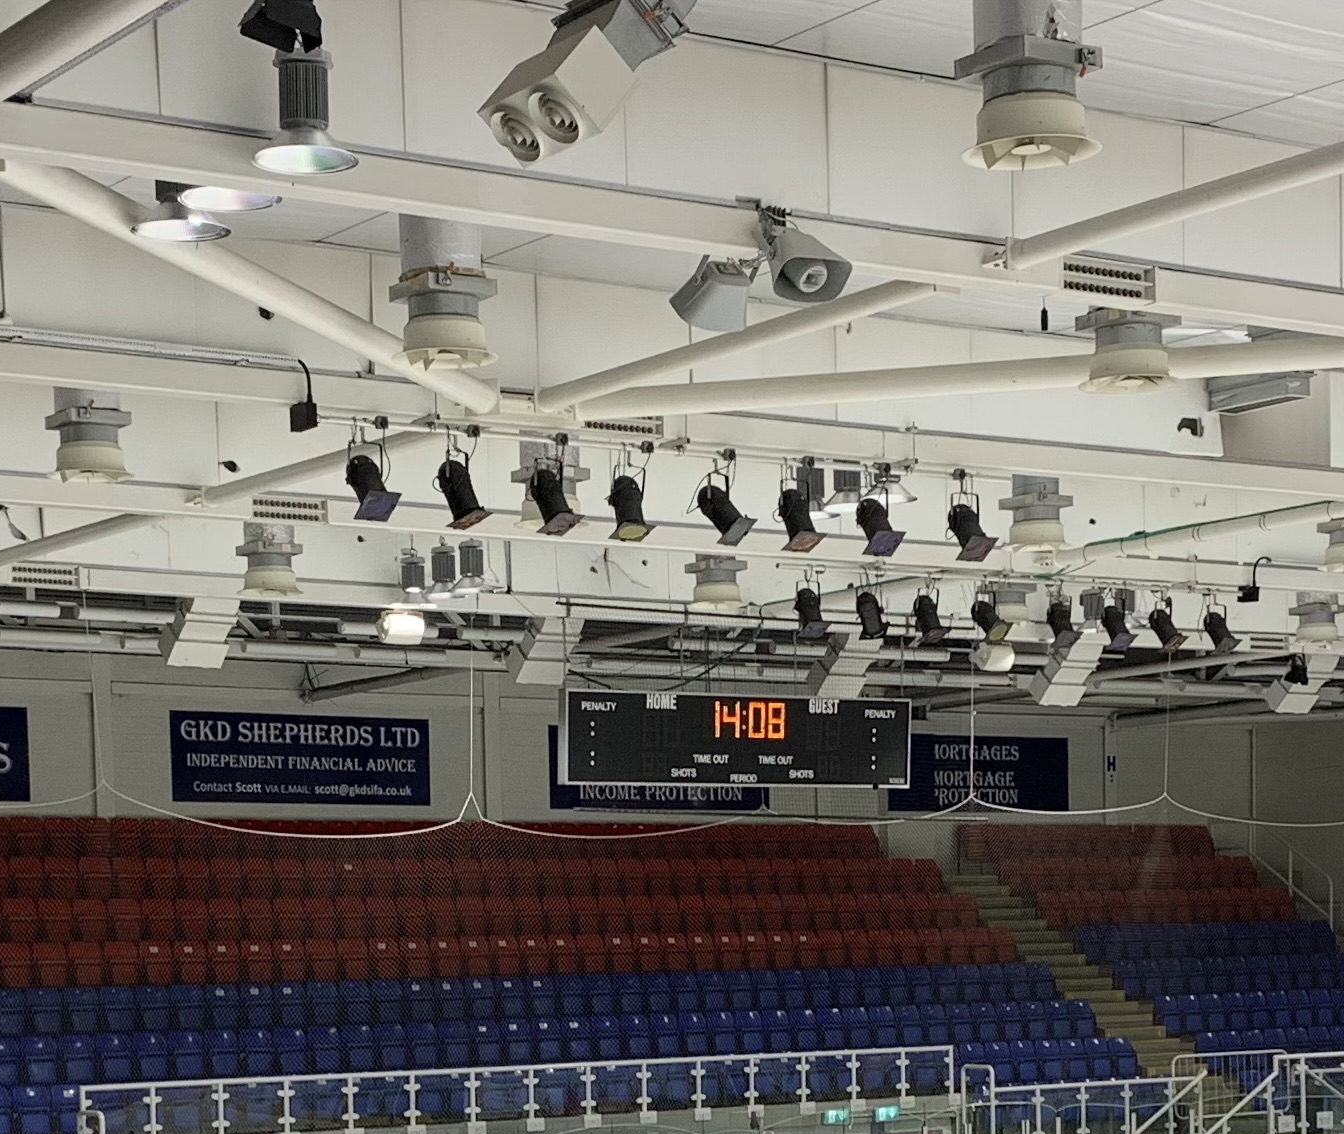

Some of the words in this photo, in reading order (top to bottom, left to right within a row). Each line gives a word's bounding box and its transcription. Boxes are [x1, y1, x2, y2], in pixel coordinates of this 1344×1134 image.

[581, 701, 616, 711] PENALTY
[646, 694, 677, 710] HOME
[809, 699, 840, 714] GUEST
[714, 701, 785, 739] 14:08
[864, 709, 896, 719] PENALTY
[180, 719, 231, 741] GKD
[238, 721, 373, 746] SHEPHERDS
[380, 727, 420, 748] LTD
[187, 753, 284, 769] INDEPENDENT
[288, 756, 362, 771] FINANCIAL
[366, 758, 416, 773] ADVICE
[693, 754, 711, 763] TIME
[713, 754, 729, 764] OUT
[758, 755, 776, 764] TIME
[777, 756, 793, 765] OUT
[1107, 756, 1116, 771] H
[671, 768, 697, 778] SHOTS
[730, 774, 757, 783] PERIOD
[789, 770, 814, 779] SHOTS
[193, 781, 232, 793] Contact
[236, 782, 261, 793] Scott
[579, 784, 640, 801] INCOME
[645, 785, 743, 802] PROTECTION
